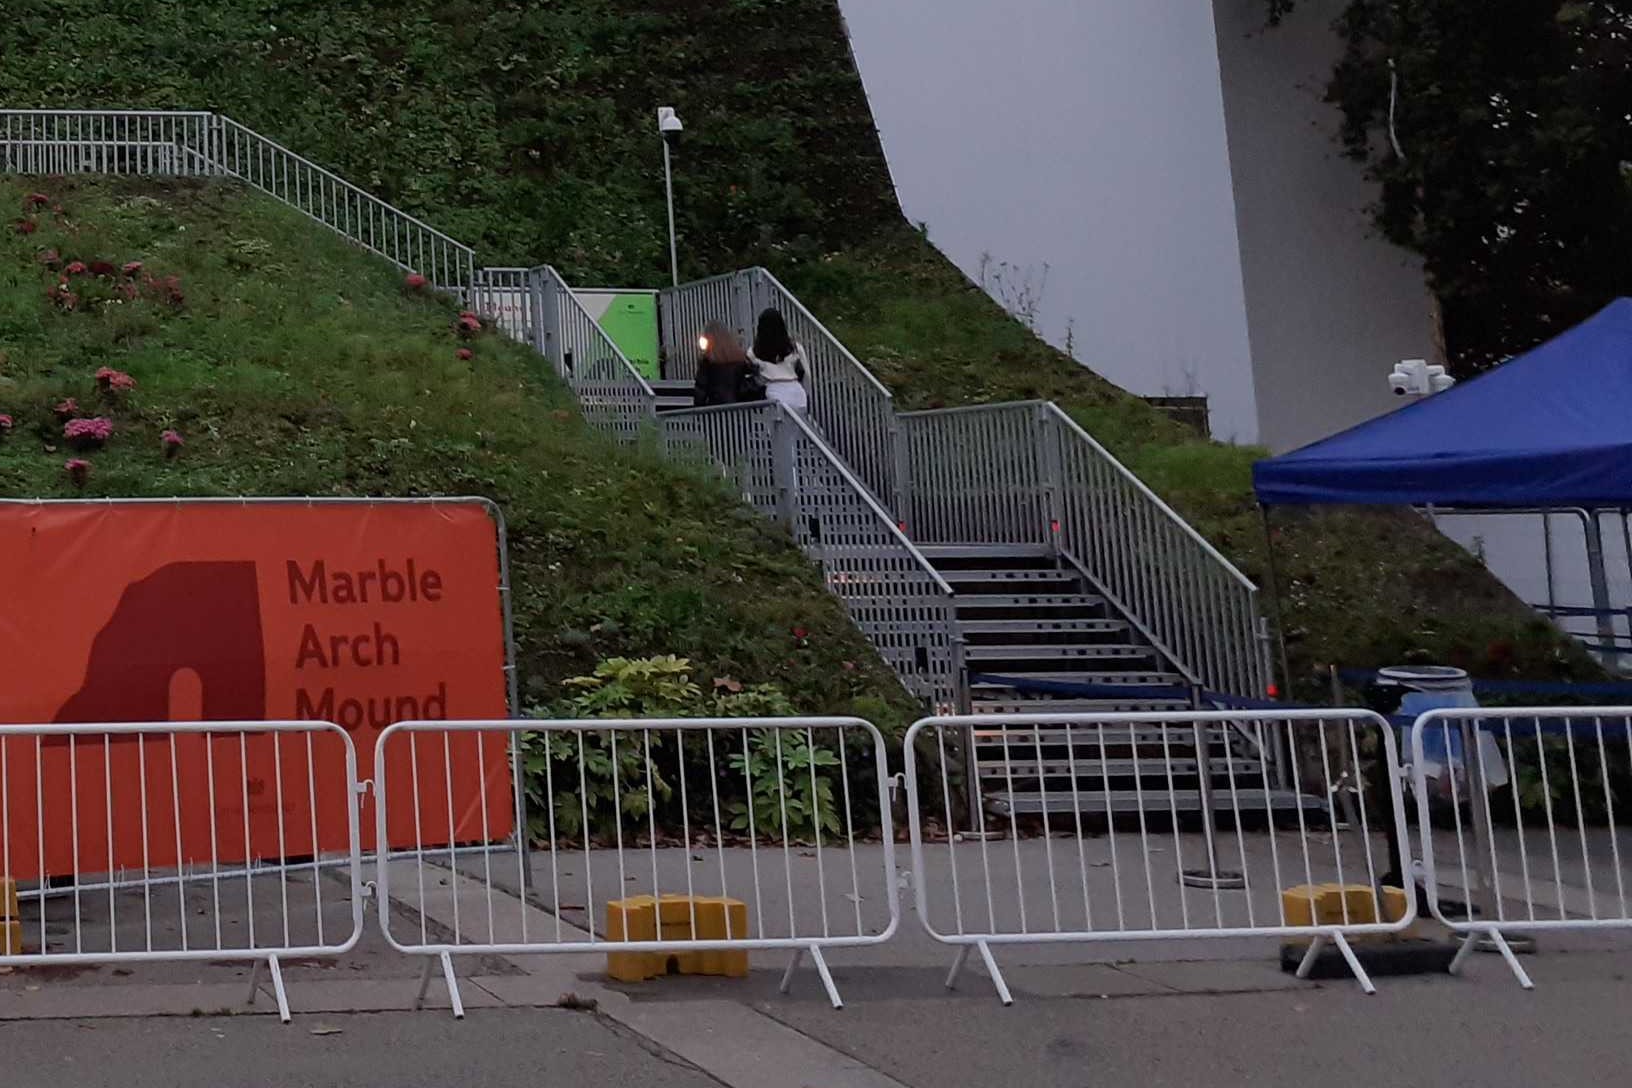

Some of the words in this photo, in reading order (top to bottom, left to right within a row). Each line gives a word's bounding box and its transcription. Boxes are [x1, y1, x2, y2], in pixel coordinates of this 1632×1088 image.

[287, 559, 443, 605] Marble
[295, 621, 401, 669] Arch
[295, 681, 447, 732] Mound
